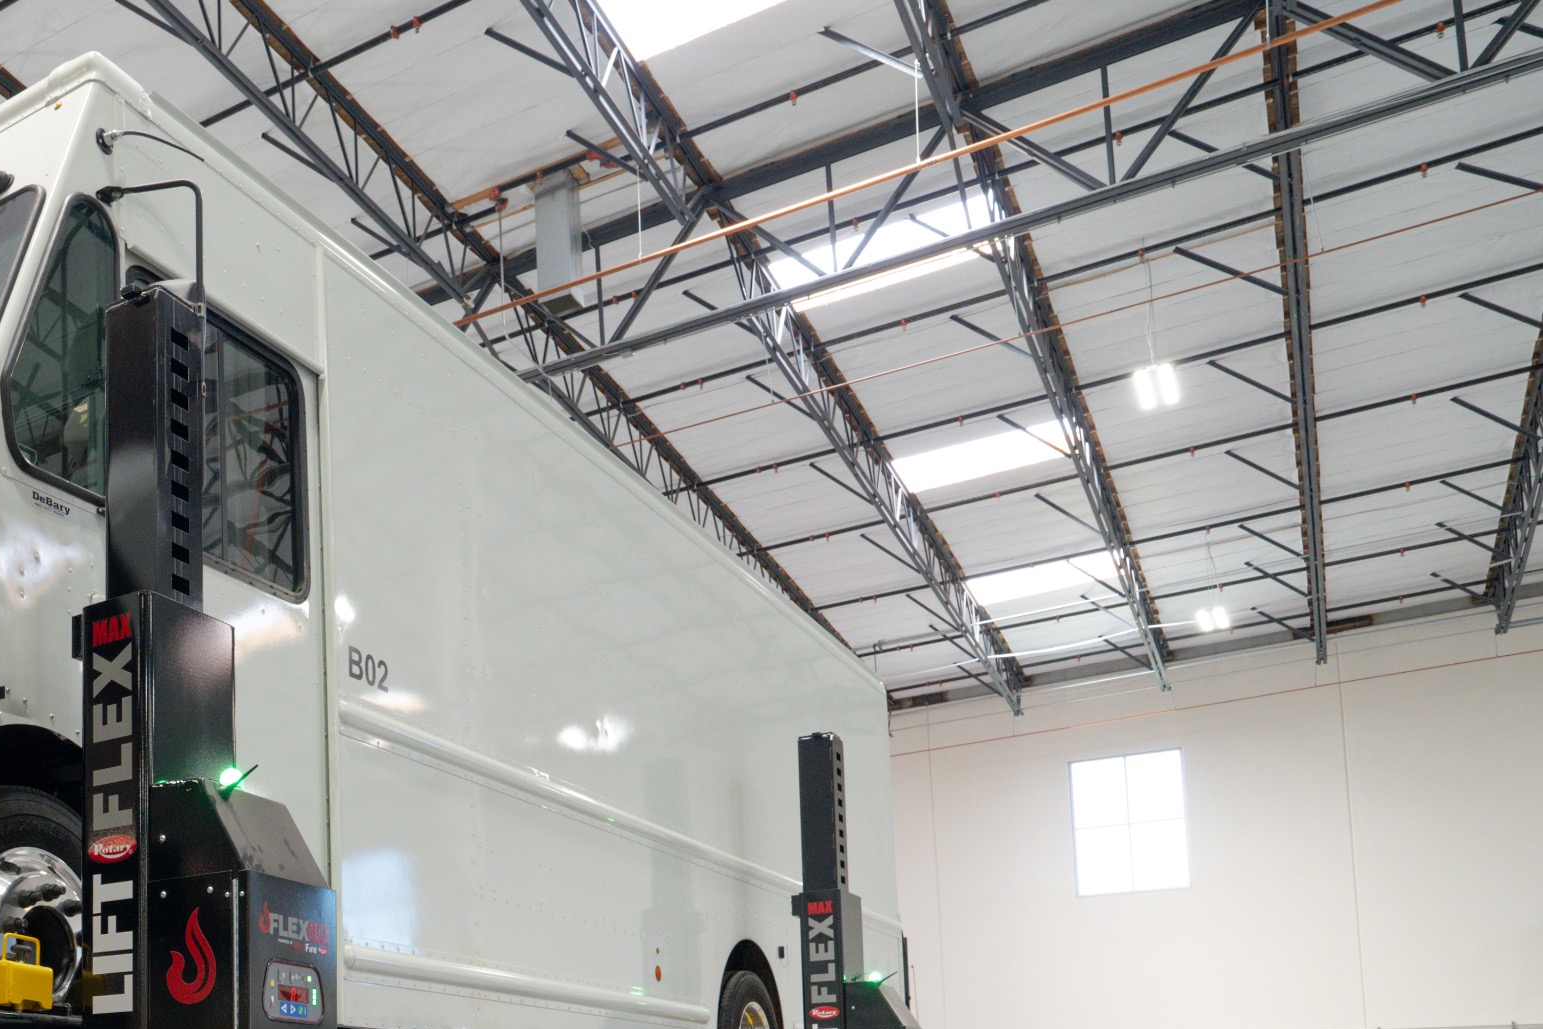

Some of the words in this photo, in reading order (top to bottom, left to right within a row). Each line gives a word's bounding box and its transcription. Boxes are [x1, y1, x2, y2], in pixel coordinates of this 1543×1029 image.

[32, 490, 71, 516] DeBary
[92, 613, 132, 647] MAX
[348, 645, 389, 693] B02
[92, 641, 133, 831] FLEX
[94, 843, 132, 859] Rotary
[807, 900, 833, 915] MAX
[92, 873, 134, 1015] LIFT
[808, 914, 837, 1004] FLEX
